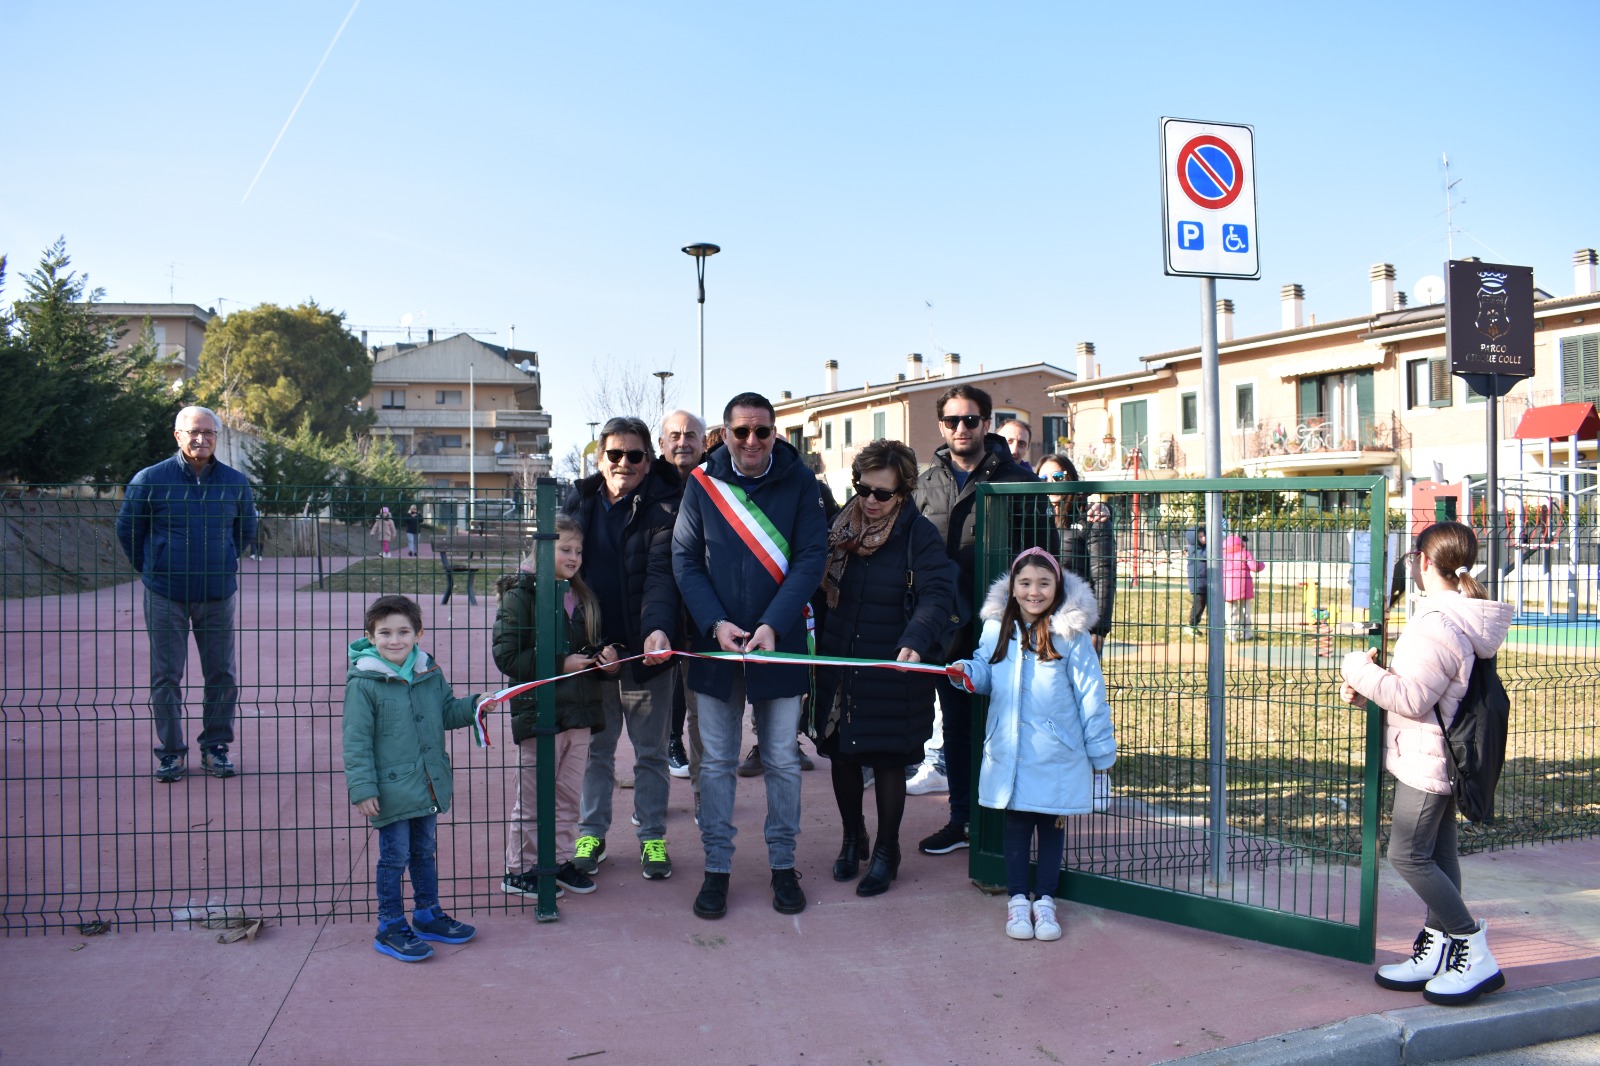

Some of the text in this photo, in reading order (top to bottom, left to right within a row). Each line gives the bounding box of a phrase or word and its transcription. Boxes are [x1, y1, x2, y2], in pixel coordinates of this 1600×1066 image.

[1183, 223, 1200, 247] P
[1480, 343, 1507, 353] PARCO
[1498, 354, 1522, 365] COLLI
